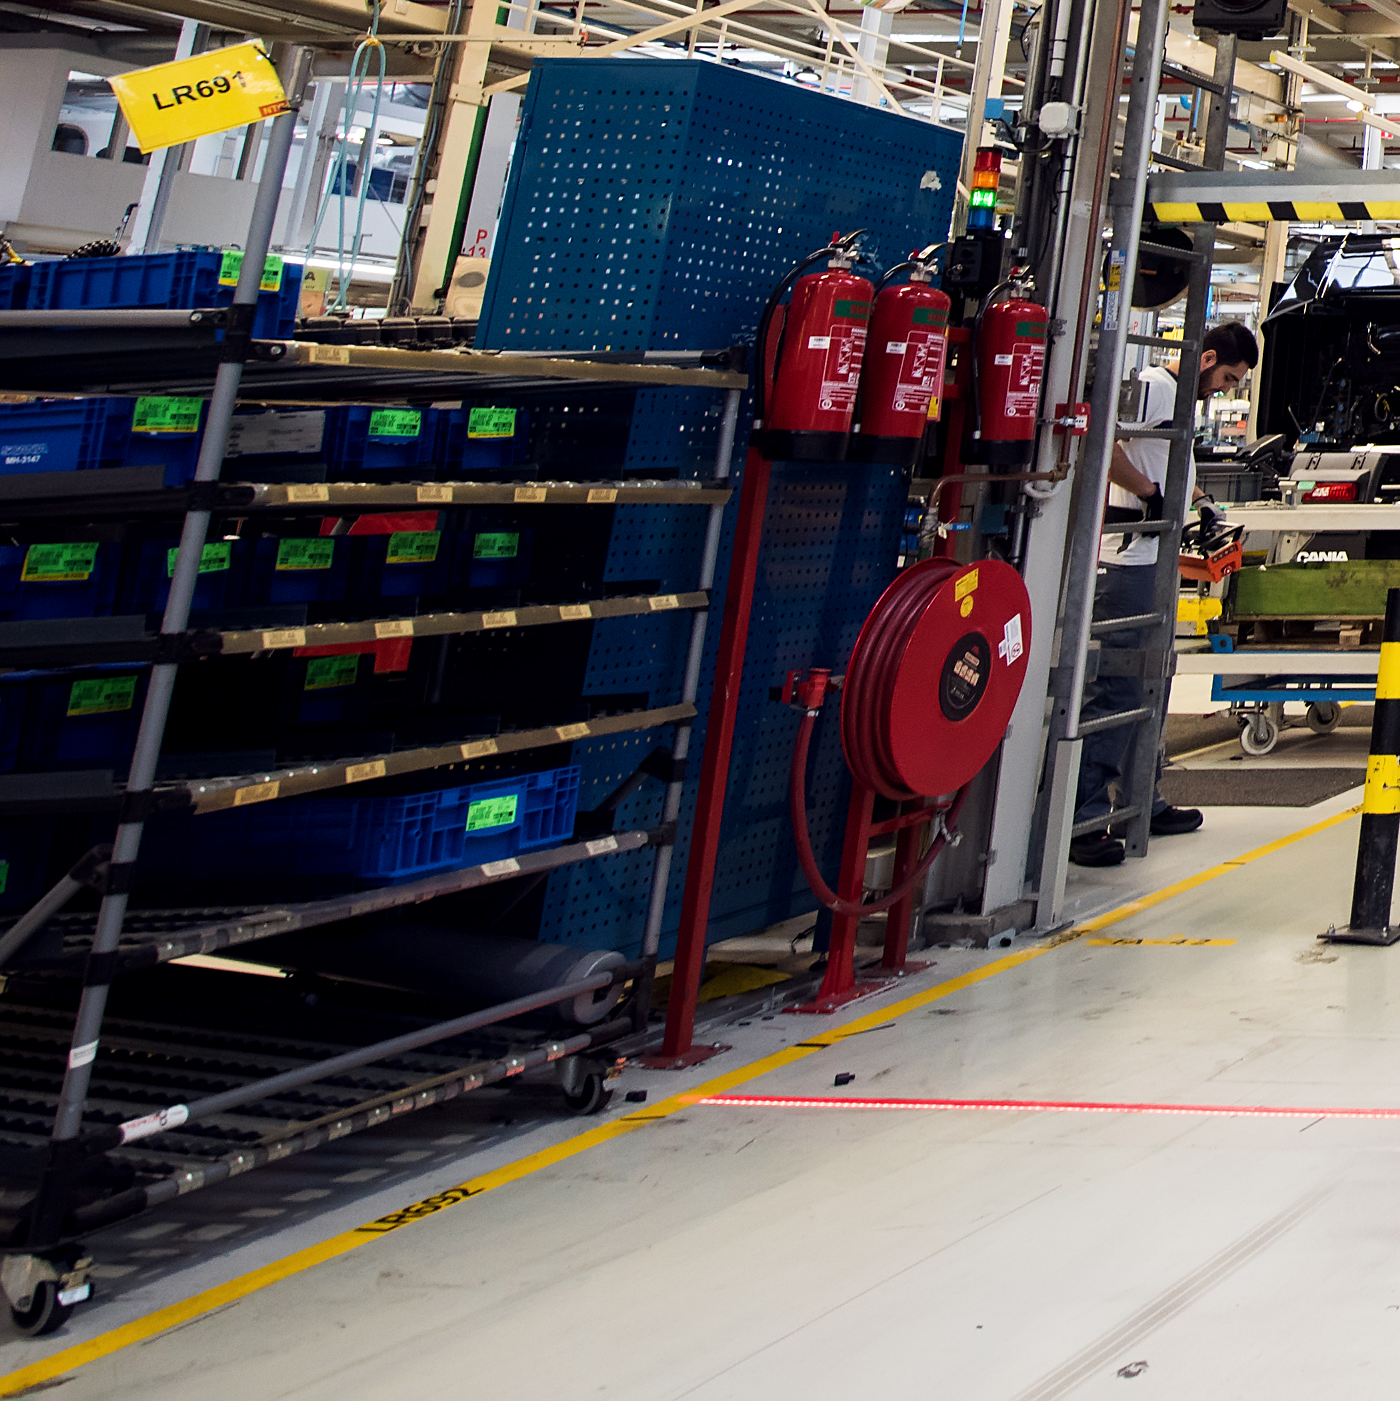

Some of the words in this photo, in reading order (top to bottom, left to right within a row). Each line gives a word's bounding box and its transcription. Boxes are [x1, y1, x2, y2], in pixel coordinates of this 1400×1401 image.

[151, 70, 247, 112] LR691
[476, 228, 488, 245] P
[1296, 551, 1349, 564] CANIA
[353, 1187, 486, 1233] LR692
